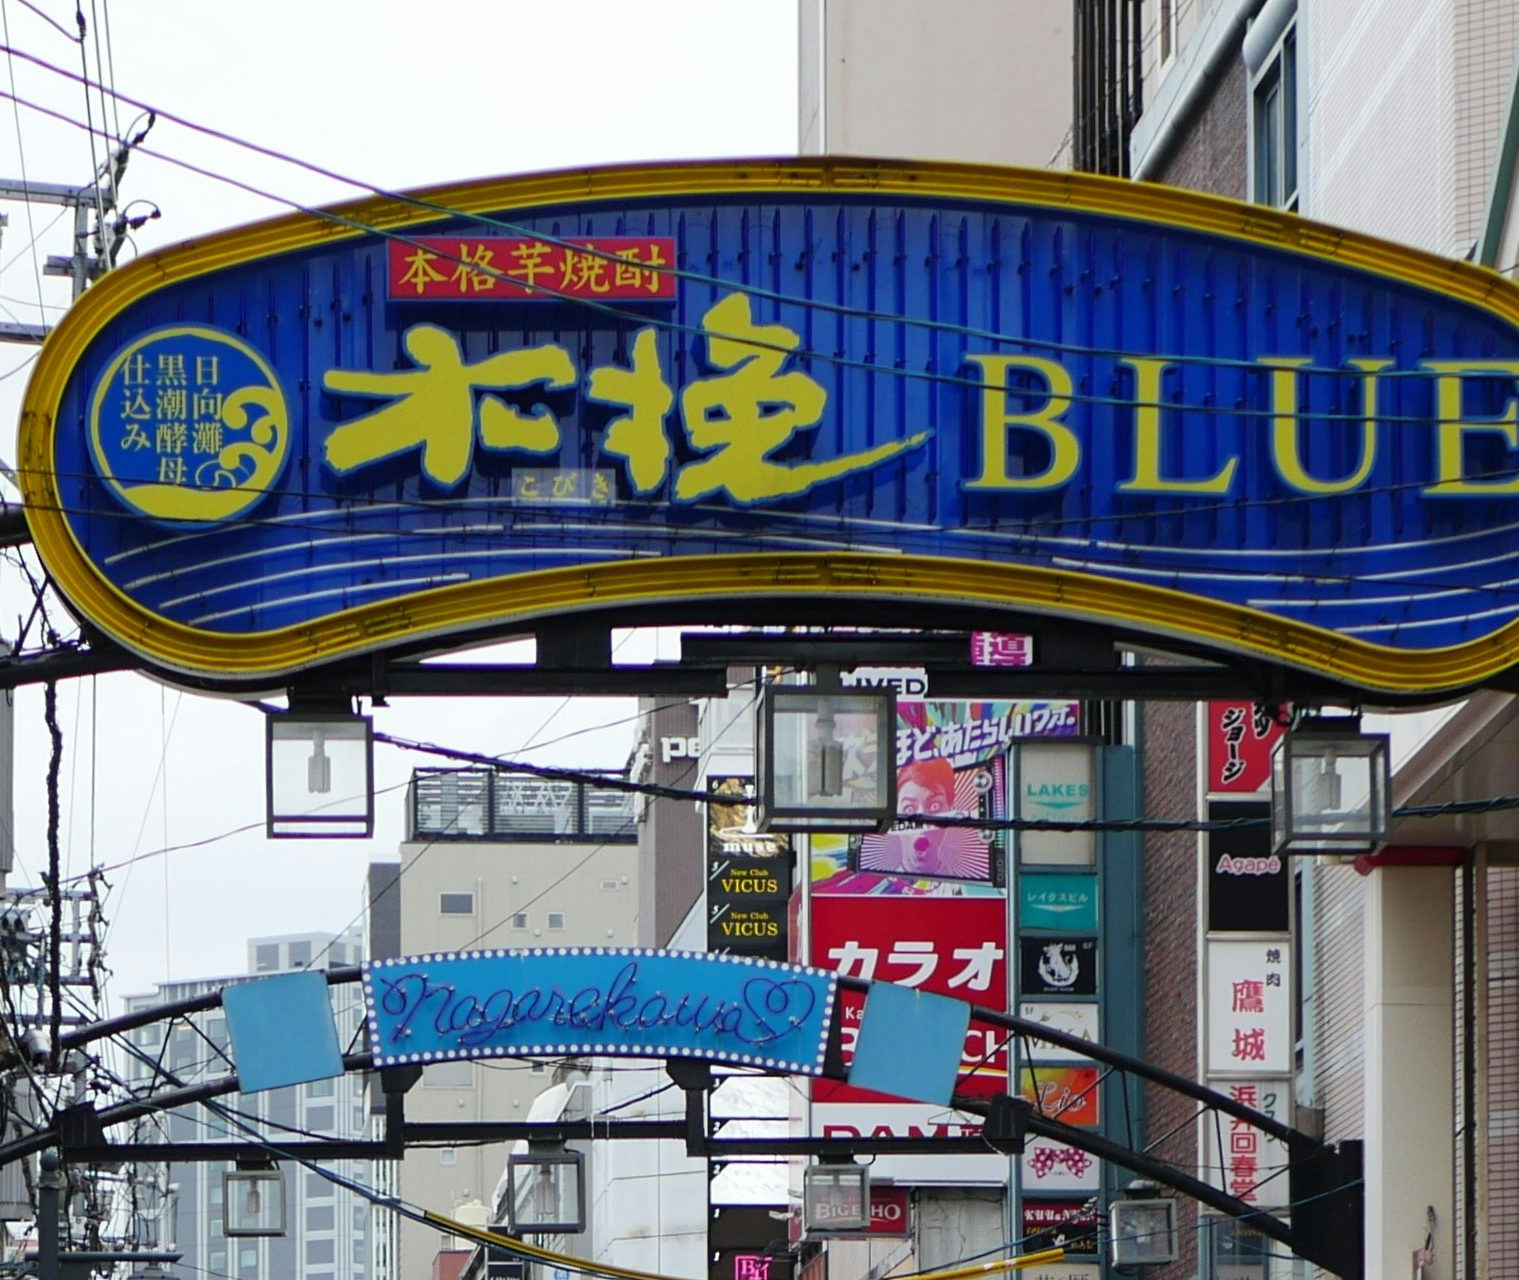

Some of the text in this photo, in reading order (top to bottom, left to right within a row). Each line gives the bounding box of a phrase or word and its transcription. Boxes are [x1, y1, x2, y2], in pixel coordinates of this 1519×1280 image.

[398, 241, 666, 296] 本格芋焼酎
[120, 353, 151, 451] 仕込み
[156, 353, 187, 486] 黒潮酵母
[192, 355, 223, 454] 日向灘
[515, 472, 614, 503] こびき
[1027, 783, 1091, 797] LAKES
[723, 839, 777, 853] muse
[721, 878, 779, 894] VICUS
[721, 922, 779, 937] VICUS
[828, 940, 1004, 992] カラオ
[1265, 948, 1281, 987] 焼肉
[1231, 979, 1266, 1061] 鷹城
[852, 1203, 902, 1221] EHO
